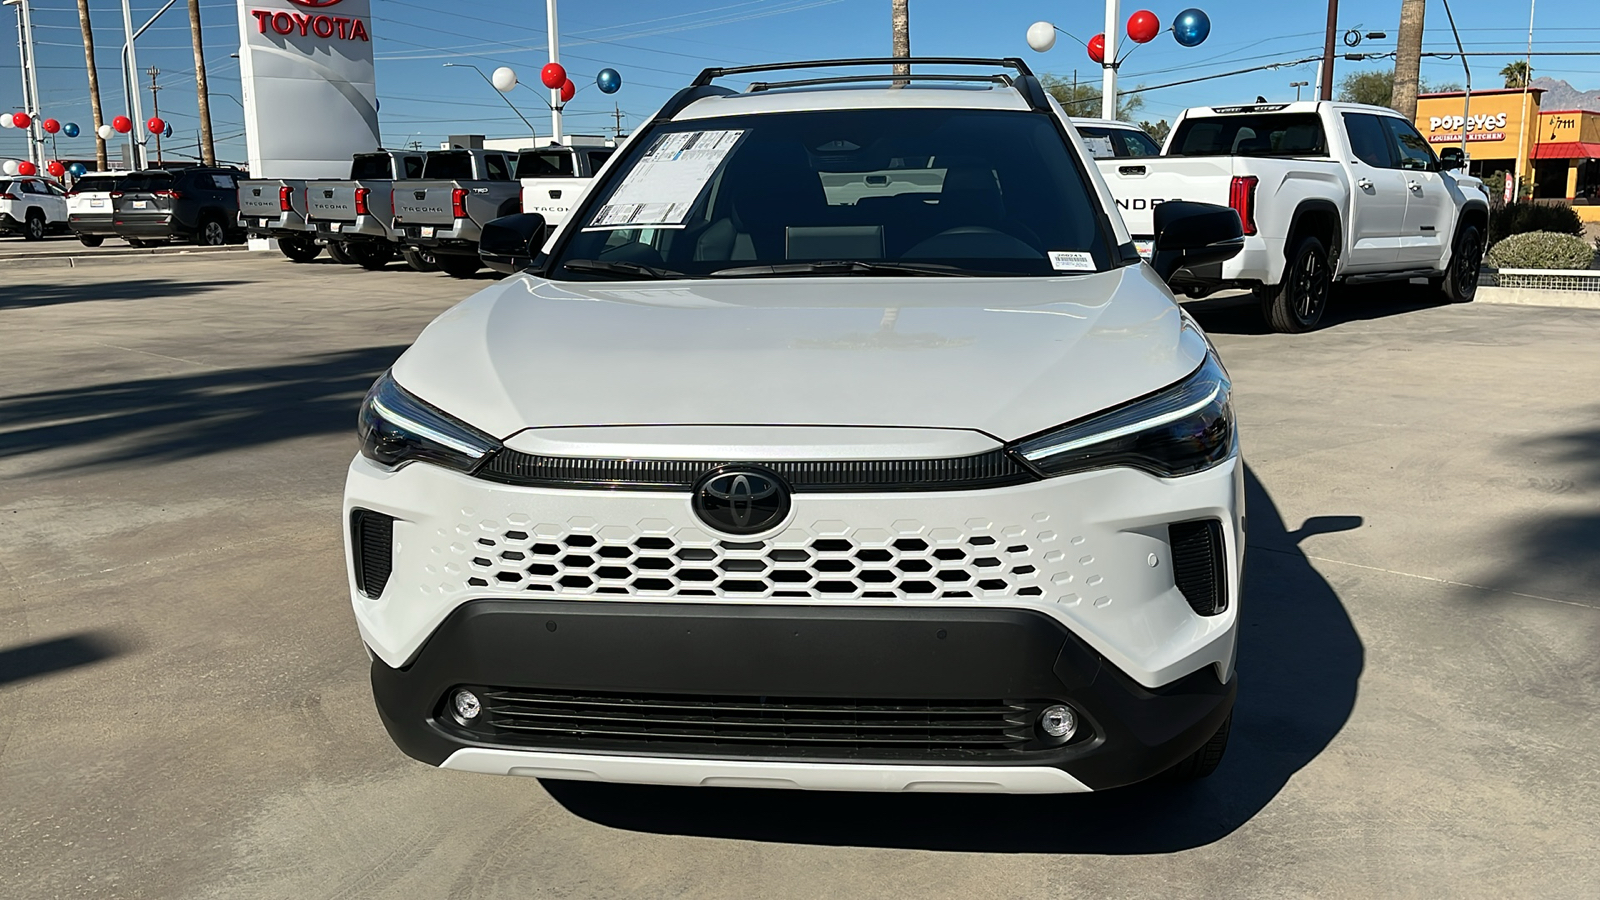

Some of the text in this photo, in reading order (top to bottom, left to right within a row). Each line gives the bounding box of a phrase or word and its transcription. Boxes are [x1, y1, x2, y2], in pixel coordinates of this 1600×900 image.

[252, 10, 369, 41] TOYOTA
[1557, 119, 1575, 129] 7111
[1430, 134, 1467, 142] LOUISIAN
